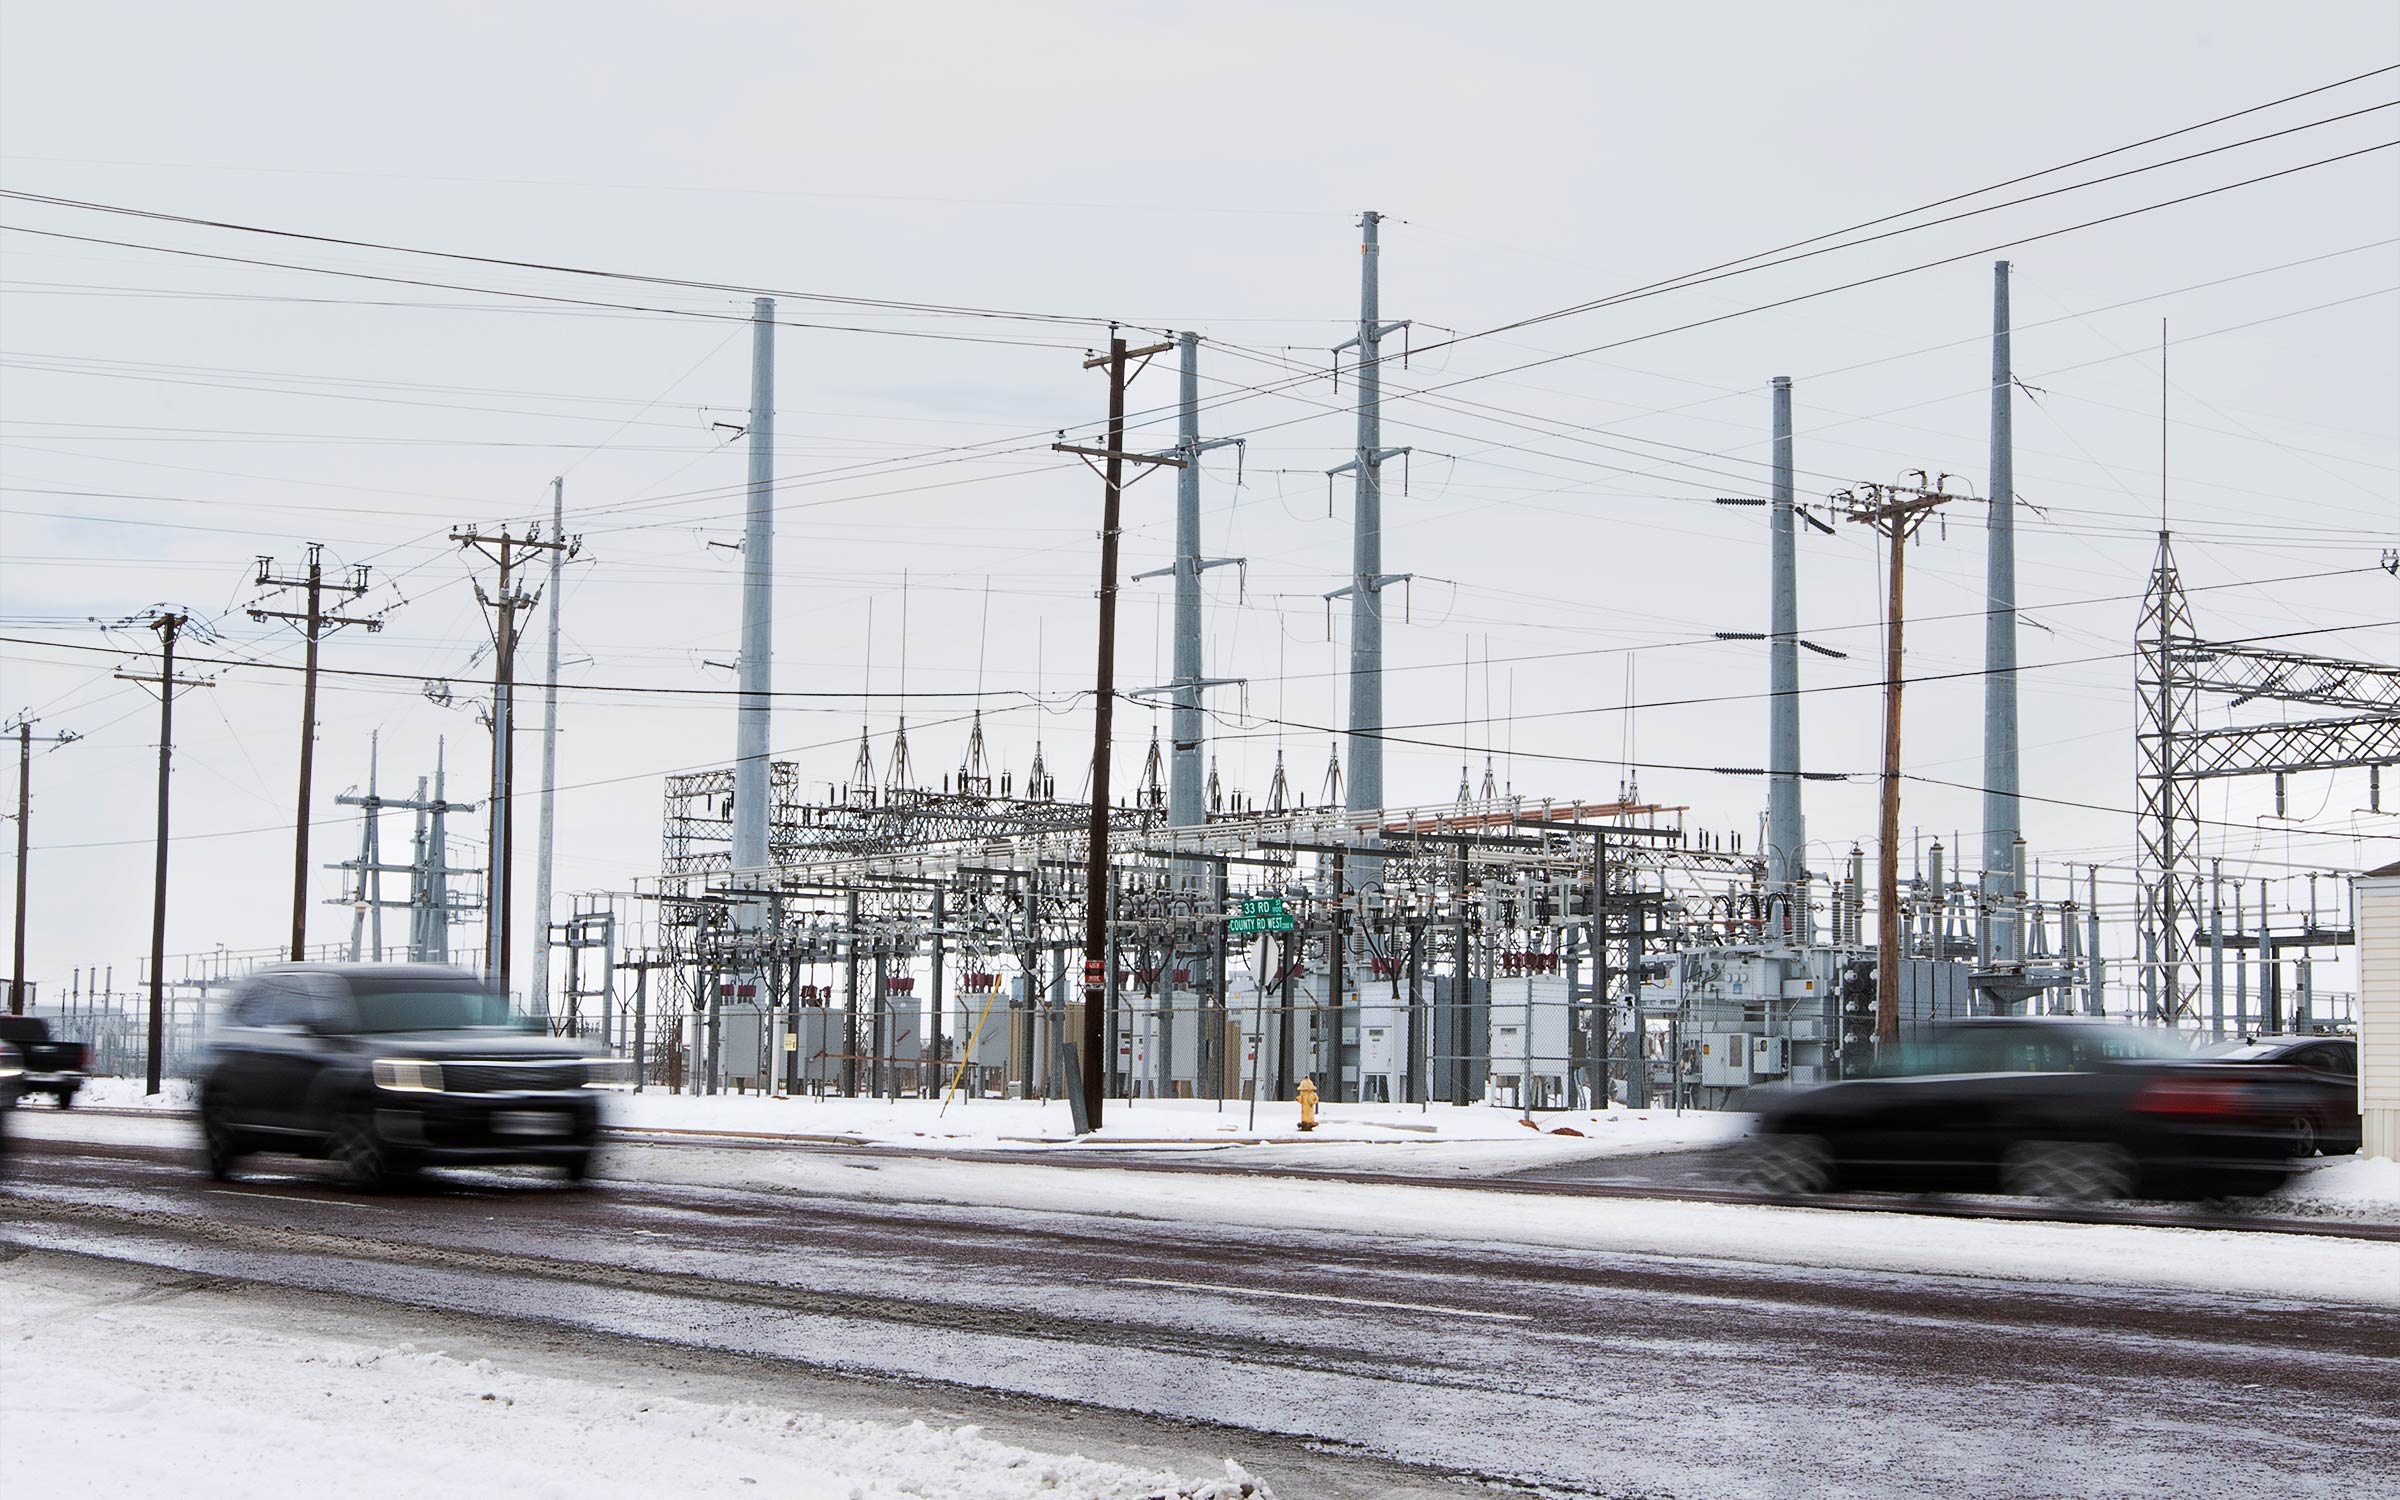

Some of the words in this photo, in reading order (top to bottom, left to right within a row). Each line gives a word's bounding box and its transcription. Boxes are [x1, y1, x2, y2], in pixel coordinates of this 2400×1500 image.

[1244, 903, 1255, 914] 33
[1258, 902, 1270, 913] RD
[1230, 918, 1255, 931] COUNTY
[1256, 918, 1265, 929] RD
[1267, 917, 1282, 928] WEST
